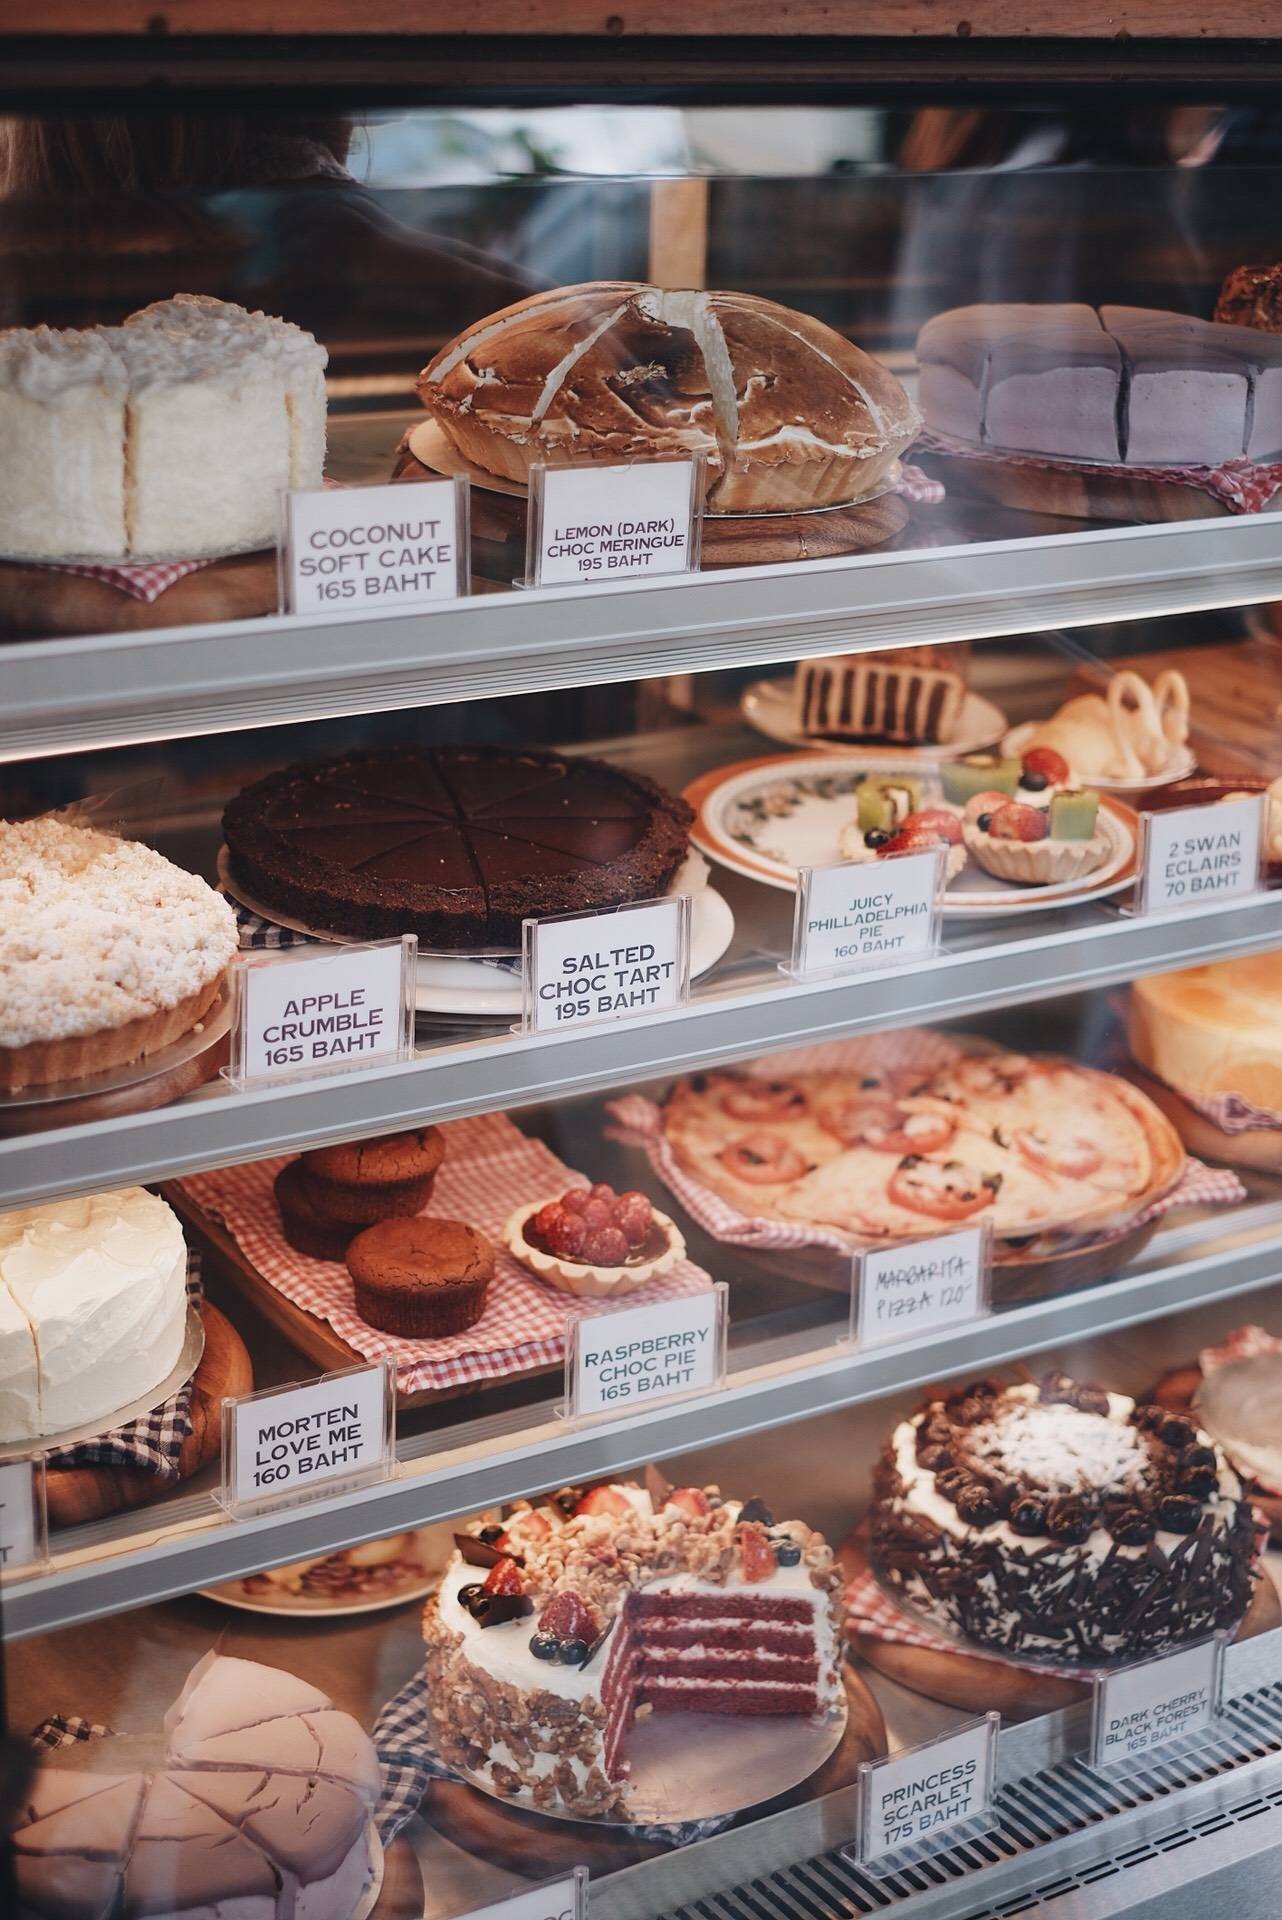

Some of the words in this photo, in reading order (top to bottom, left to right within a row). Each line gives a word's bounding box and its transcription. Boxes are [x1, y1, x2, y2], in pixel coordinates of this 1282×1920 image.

[310, 521, 441, 549] COCONUT
[555, 524, 612, 541] LEMON
[617, 518, 674, 537] (DARK)
[300, 552, 370, 576] SOFT
[378, 545, 451, 568] CAKE
[547, 542, 594, 558] CHOC
[600, 535, 685, 553] MERINGUE
[578, 558, 602, 571] 195
[608, 553, 653, 568] BAHT
[317, 580, 356, 601] 165
[365, 571, 436, 596] BAHT
[1169, 843, 1178, 858] 2
[1184, 832, 1240, 855] SWAN
[1166, 851, 1241, 878] ECLAIRS
[1165, 882, 1185, 897] 70
[1191, 872, 1239, 892] BAHT
[808, 902, 928, 933] PHILLADELPHIA
[849, 893, 893, 911] JUICY
[835, 945, 858, 958] 160
[863, 936, 904, 953] BAHT
[859, 925, 883, 939] PIE
[563, 944, 655, 974] SALTED
[539, 975, 606, 1000] CHOC
[614, 962, 674, 987] TART
[283, 989, 365, 1018] APPLE
[555, 1000, 590, 1020] 195
[598, 987, 660, 1013] BAHT
[263, 1008, 383, 1044] CRUMBLE
[265, 1045, 303, 1066] 165
[312, 1031, 380, 1059] BAHT
[877, 1290, 934, 1319] PIZZA
[585, 1328, 709, 1367] RASPBERRY
[599, 1358, 657, 1382] CHOC
[665, 1350, 696, 1367] PIE
[600, 1382, 630, 1401] 165
[638, 1368, 694, 1392] BAHT
[258, 1404, 358, 1445] MORTEN
[256, 1434, 321, 1467] LOVE
[329, 1424, 361, 1445] ME
[253, 1464, 290, 1487] 160
[299, 1443, 364, 1474] BAHT
[1106, 1722, 1152, 1745] BLACK
[1157, 1699, 1208, 1727] FOREST
[1110, 1709, 1149, 1731] DARK
[1153, 1688, 1205, 1715] CHERRY
[1127, 1736, 1147, 1751] 165
[1151, 1721, 1187, 1742] BAHT
[882, 1760, 976, 1809] PRINCESS
[884, 1779, 974, 1826] SCARLET
[884, 1822, 912, 1845] 175
[920, 1797, 972, 1831] BAHT
